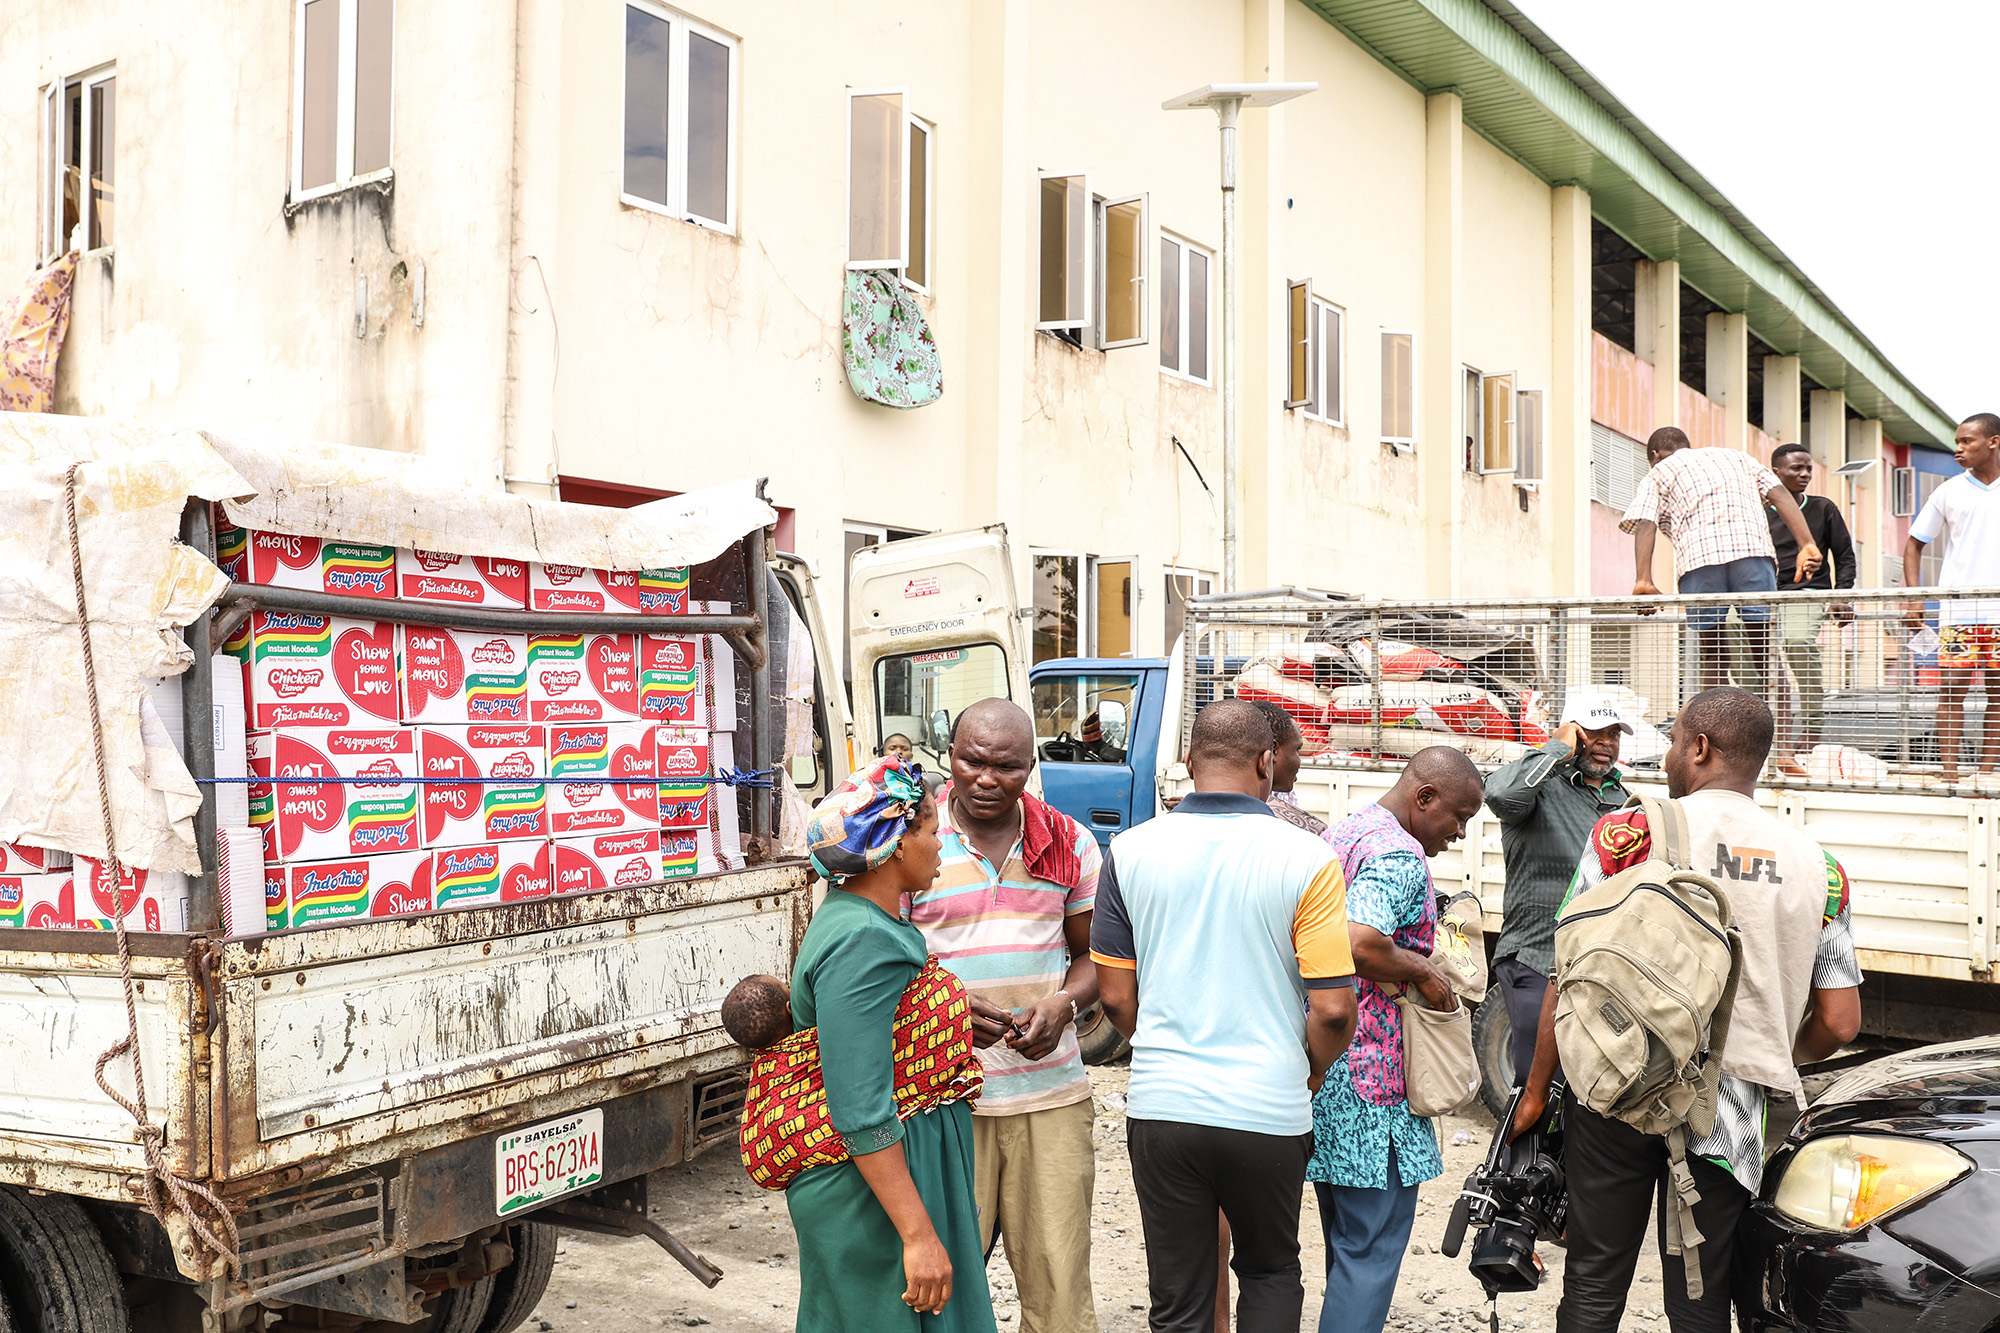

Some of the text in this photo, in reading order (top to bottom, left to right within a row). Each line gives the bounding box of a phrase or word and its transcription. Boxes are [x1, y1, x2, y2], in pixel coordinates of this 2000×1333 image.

[256, 535, 302, 558] Show
[335, 547, 382, 559] Instant Noodles
[417, 580, 475, 598] Indomitables
[890, 619, 964, 636] EMERGENCY DOOR
[267, 644, 318, 654] Instant Noodles
[351, 640, 392, 660] Show
[474, 650, 514, 663] Chicken
[537, 649, 575, 657] Instant Noodles
[600, 644, 633, 663] Show
[415, 656, 440, 666] some
[913, 650, 958, 664] EMERGENCY EXIT
[359, 664, 387, 674] some
[607, 666, 629, 676] some
[270, 669, 319, 685] Chicken
[410, 668, 448, 689] Show
[499, 677, 516, 685] Instant
[541, 671, 578, 686] Chicken
[651, 673, 689, 683] Instant Noodles
[281, 684, 305, 693] Flavor
[550, 683, 567, 691] Flavor
[271, 706, 338, 727] Indomitables
[544, 702, 596, 721] Indomitables
[338, 731, 400, 752] Indomitables
[553, 731, 603, 755] Indomie
[492, 763, 533, 777] Chicken
[623, 754, 654, 772] Show
[287, 785, 318, 796] some
[495, 792, 536, 801] Instant Noodles
[565, 783, 601, 797] Chicken
[427, 790, 467, 809] Show
[281, 800, 327, 821] Show
[360, 804, 385, 812] Noodles
[567, 812, 618, 831] Indomitables
[438, 853, 494, 880] Indomie
[675, 867, 694, 875] Noodles
[617, 867, 651, 883] Chicken
[295, 869, 363, 899] Indomie
[450, 885, 487, 896] Instant Noodles
[515, 874, 548, 893] Show
[306, 905, 356, 917] Instant Noodles
[389, 893, 429, 914] Show
[524, 1122, 576, 1143] BAYELSA
